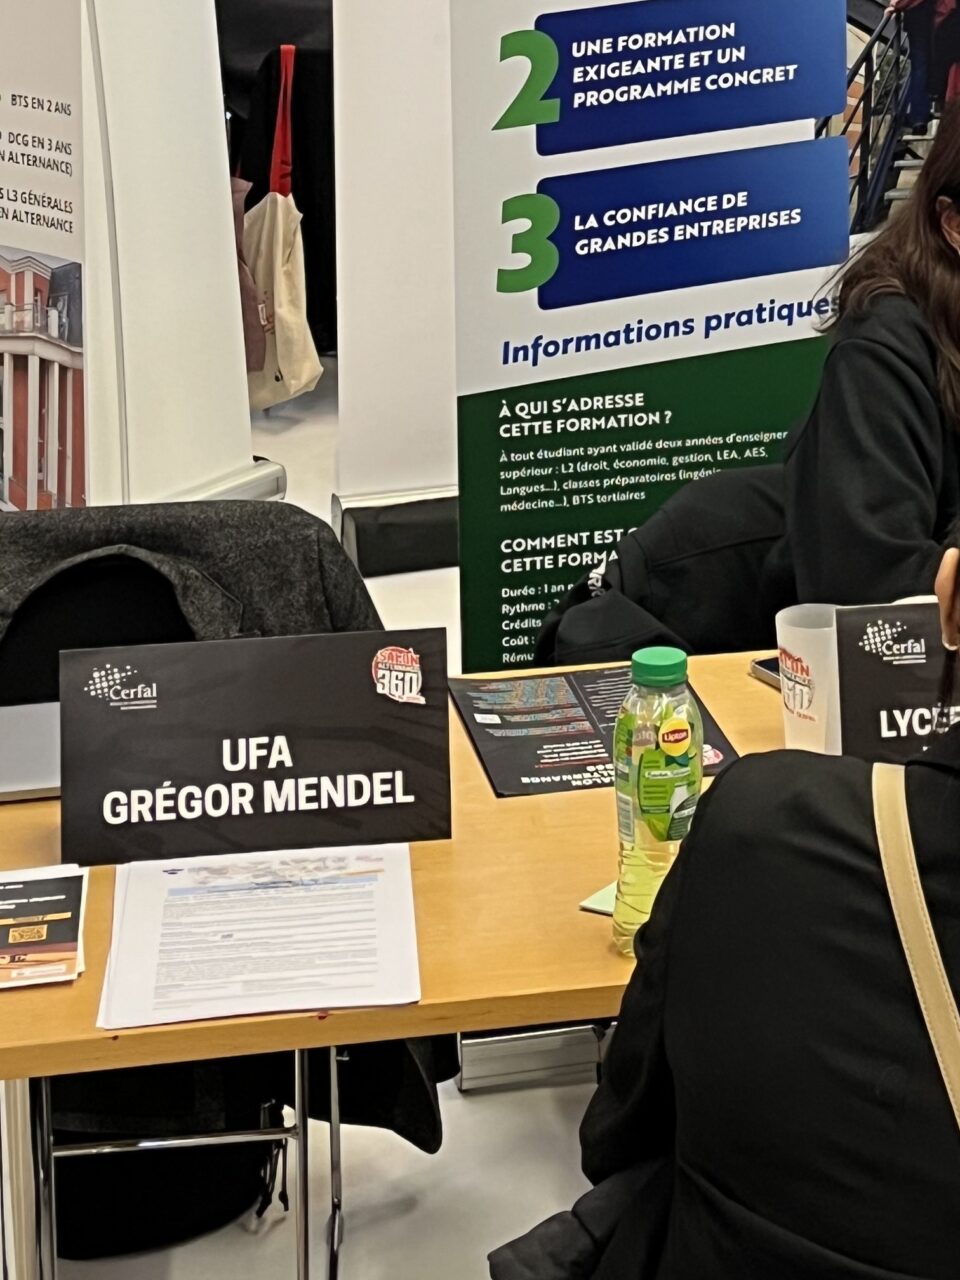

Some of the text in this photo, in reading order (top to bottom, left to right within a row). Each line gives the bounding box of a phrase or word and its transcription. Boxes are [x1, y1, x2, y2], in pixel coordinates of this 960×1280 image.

[572, 23, 735, 57] UNE FORMATION
[573, 46, 745, 83] EXIGEANTE ET UN
[491, 30, 560, 130] 2
[573, 65, 797, 107] PROGRAMME CONCRET
[11, 94, 71, 116] BTS EN 2 ANS
[9, 132, 28, 147] DCG
[32, 136, 44, 149] EN
[55, 140, 72, 155] ANS
[21, 190, 72, 213] GÉNÉRALES
[574, 192, 748, 231] LA CONFIANCE DE
[12, 211, 73, 233] ALTERNANCE
[575, 209, 801, 255] GRANDES ENTREPRISES
[496, 193, 560, 293] 3
[502, 314, 694, 366] Informations
[500, 400, 510, 418] À
[516, 401, 548, 419] QUI
[500, 420, 552, 438] CETTE
[557, 412, 660, 433] FORMATION
[511, 452, 534, 461] tout
[537, 448, 584, 459] étudiant
[587, 444, 617, 456] ayant
[620, 439, 653, 452] validé
[655, 440, 682, 449] deux
[685, 436, 723, 446] années
[500, 467, 552, 479] supérieur
[563, 480, 600, 490] classes
[603, 471, 677, 488] préparatoires
[572, 494, 594, 506] BTS
[597, 491, 645, 503] tertiaires
[500, 532, 590, 552] COMMENT
[594, 529, 624, 544] EST
[501, 555, 554, 573] CETTE
[502, 585, 535, 598] Durée
[551, 584, 564, 593] an
[502, 603, 545, 616] Rythme
[502, 619, 542, 630] Crédits
[502, 636, 528, 646] Coût
[882, 639, 925, 655] Cerfal
[109, 683, 157, 700] Cerfal
[377, 670, 419, 696] 360
[222, 735, 292, 772] UFA
[103, 770, 414, 825] GRÉGOR MENDEL
